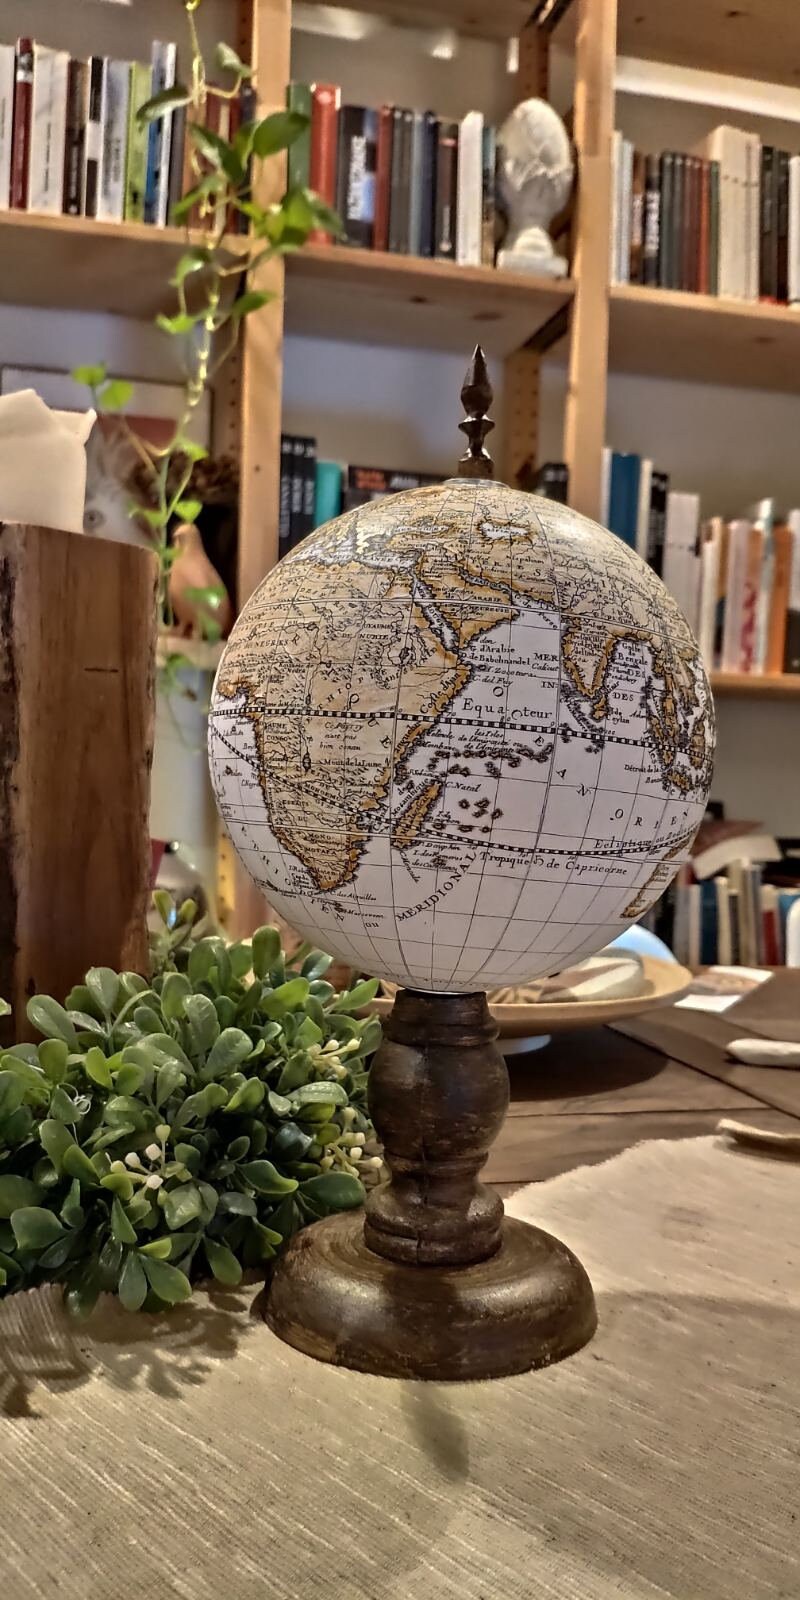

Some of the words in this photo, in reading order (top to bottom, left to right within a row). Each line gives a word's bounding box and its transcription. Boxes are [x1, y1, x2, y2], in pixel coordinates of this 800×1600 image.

[533, 652, 559, 662] MER
[613, 691, 635, 701] DES
[479, 851, 530, 869] Tropique
[546, 858, 561, 869] de
[565, 859, 628, 876] Capricorne
[394, 850, 478, 922] MERIDIONAL
